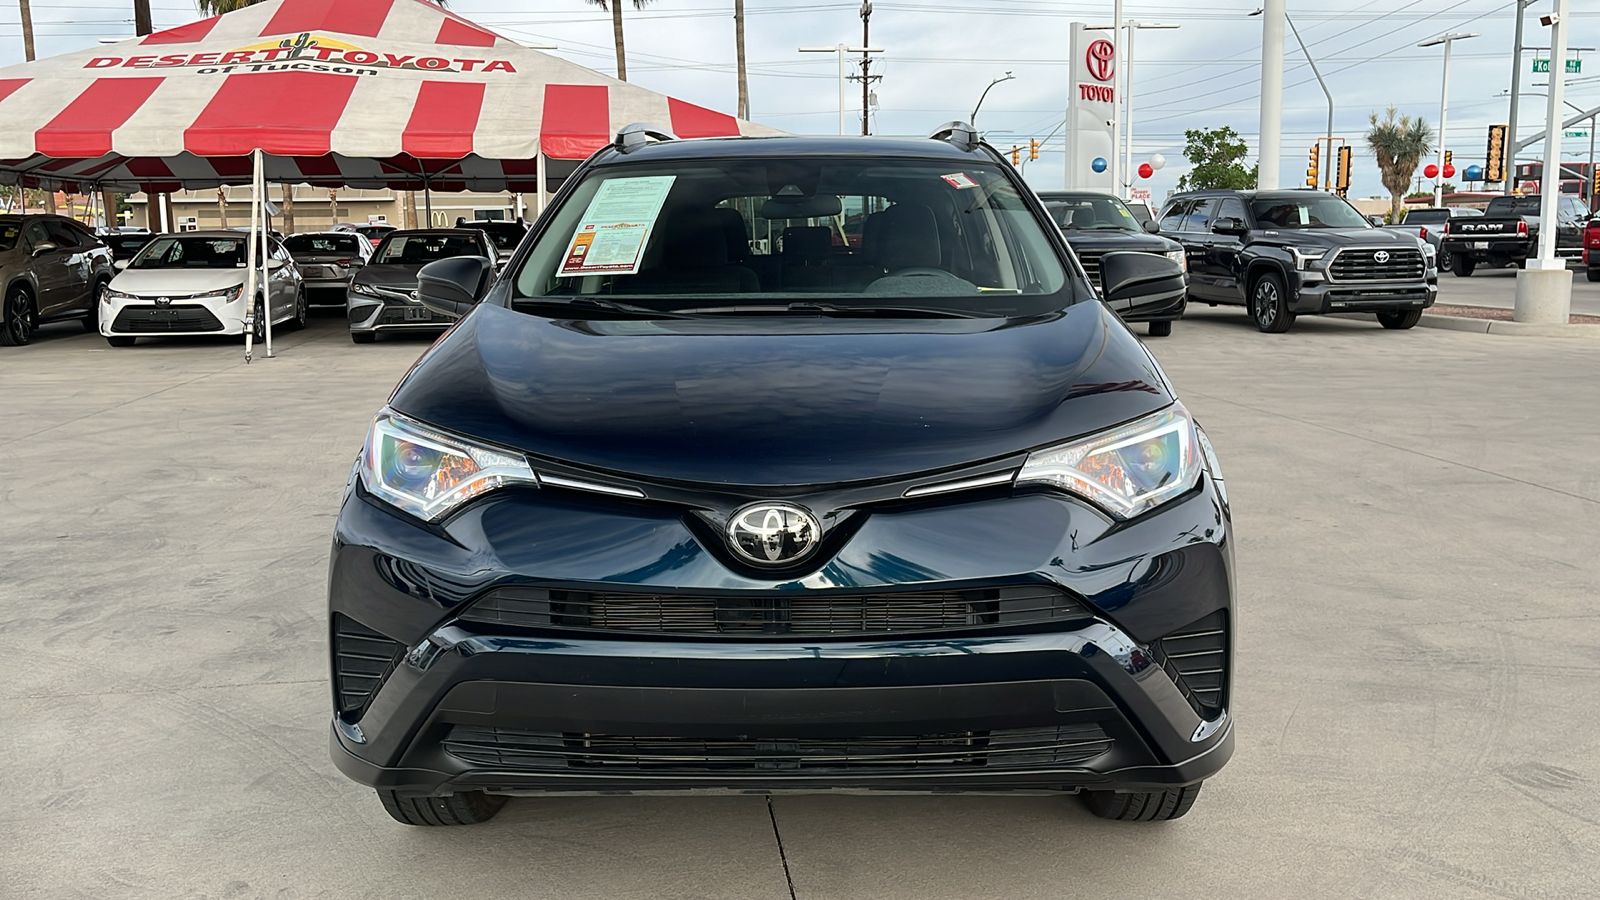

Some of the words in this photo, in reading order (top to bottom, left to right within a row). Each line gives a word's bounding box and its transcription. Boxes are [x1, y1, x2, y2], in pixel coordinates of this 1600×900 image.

[83, 47, 292, 69] DESERT
[310, 46, 517, 73] TOYOTA
[197, 65, 237, 74] of
[251, 62, 378, 77] Tucson
[1079, 84, 1121, 104] TOYOT
[1461, 223, 1504, 231] RAM
